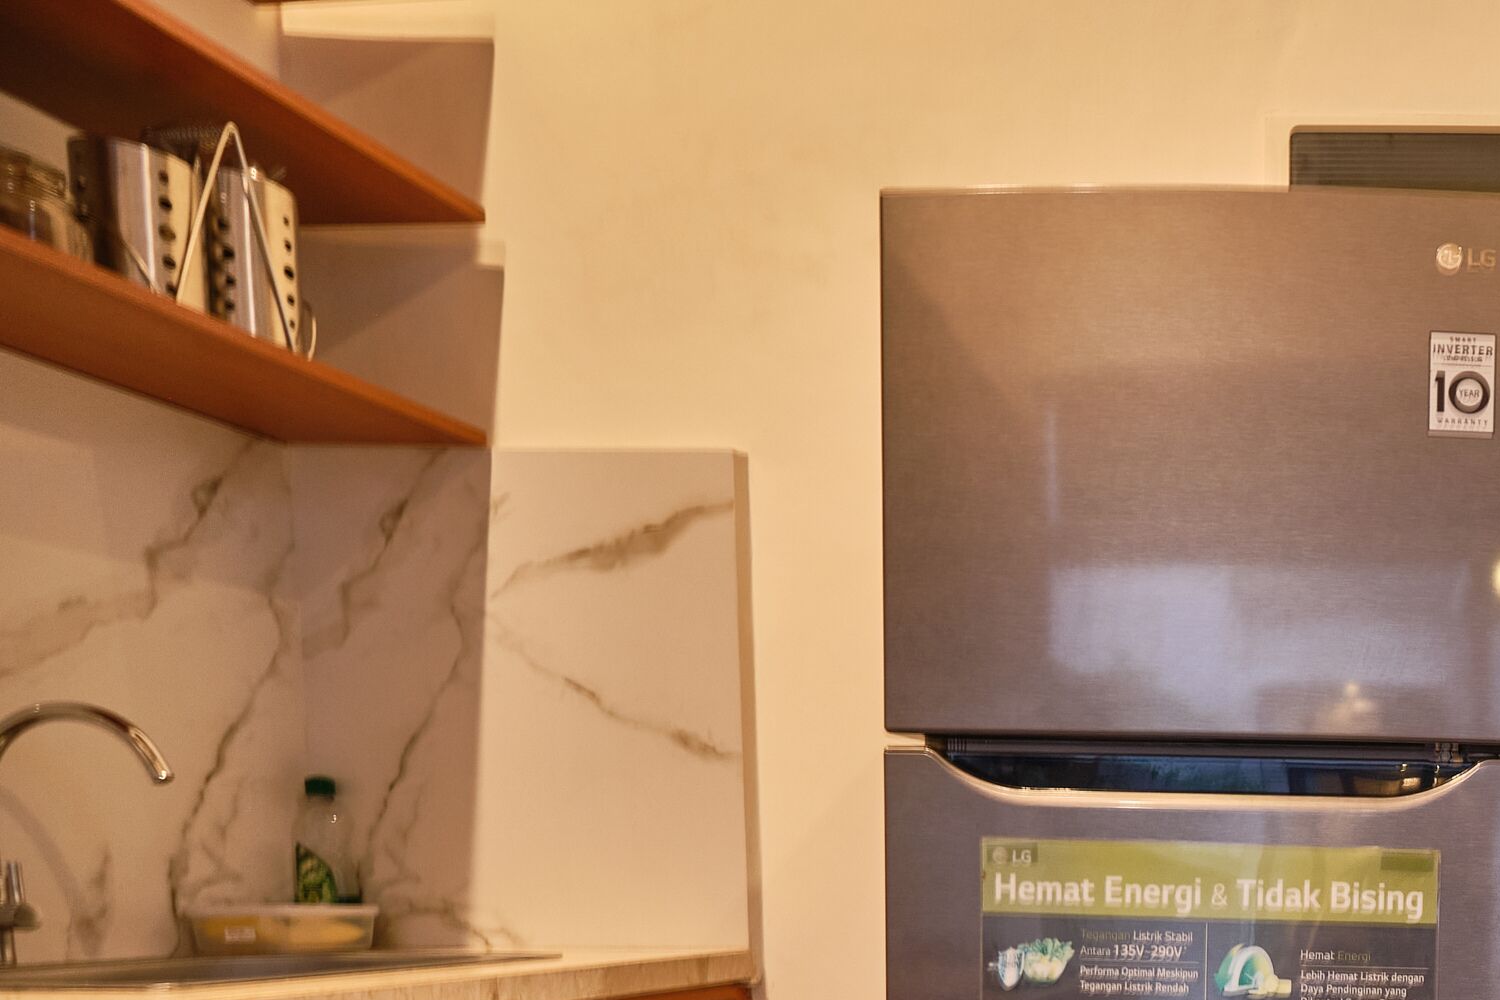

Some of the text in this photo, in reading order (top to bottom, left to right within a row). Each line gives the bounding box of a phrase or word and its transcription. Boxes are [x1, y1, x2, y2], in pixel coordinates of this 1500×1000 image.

[1467, 248, 1497, 268] LG
[1432, 344, 1494, 356] INVERTER
[1434, 370, 1491, 414] 10
[1459, 389, 1480, 398] YEAR
[1437, 417, 1489, 426] WARRANTY
[1012, 849, 1032, 863] LG
[995, 873, 1424, 921] Hemat Energi & Tidak Bising
[1133, 930, 1162, 941] Listrik
[1165, 931, 1193, 942] Stabil
[1080, 946, 1111, 957] Antara
[1300, 949, 1371, 963] Hemat Energi
[1080, 965, 1198, 979] Performa Optimal Meskipun
[1300, 970, 1425, 983] Lebih Hemat Listrik dengan
[1080, 981, 1189, 993] Tegangan Listrik Rendah
[1300, 984, 1407, 998] Daya Pendinginan yang
